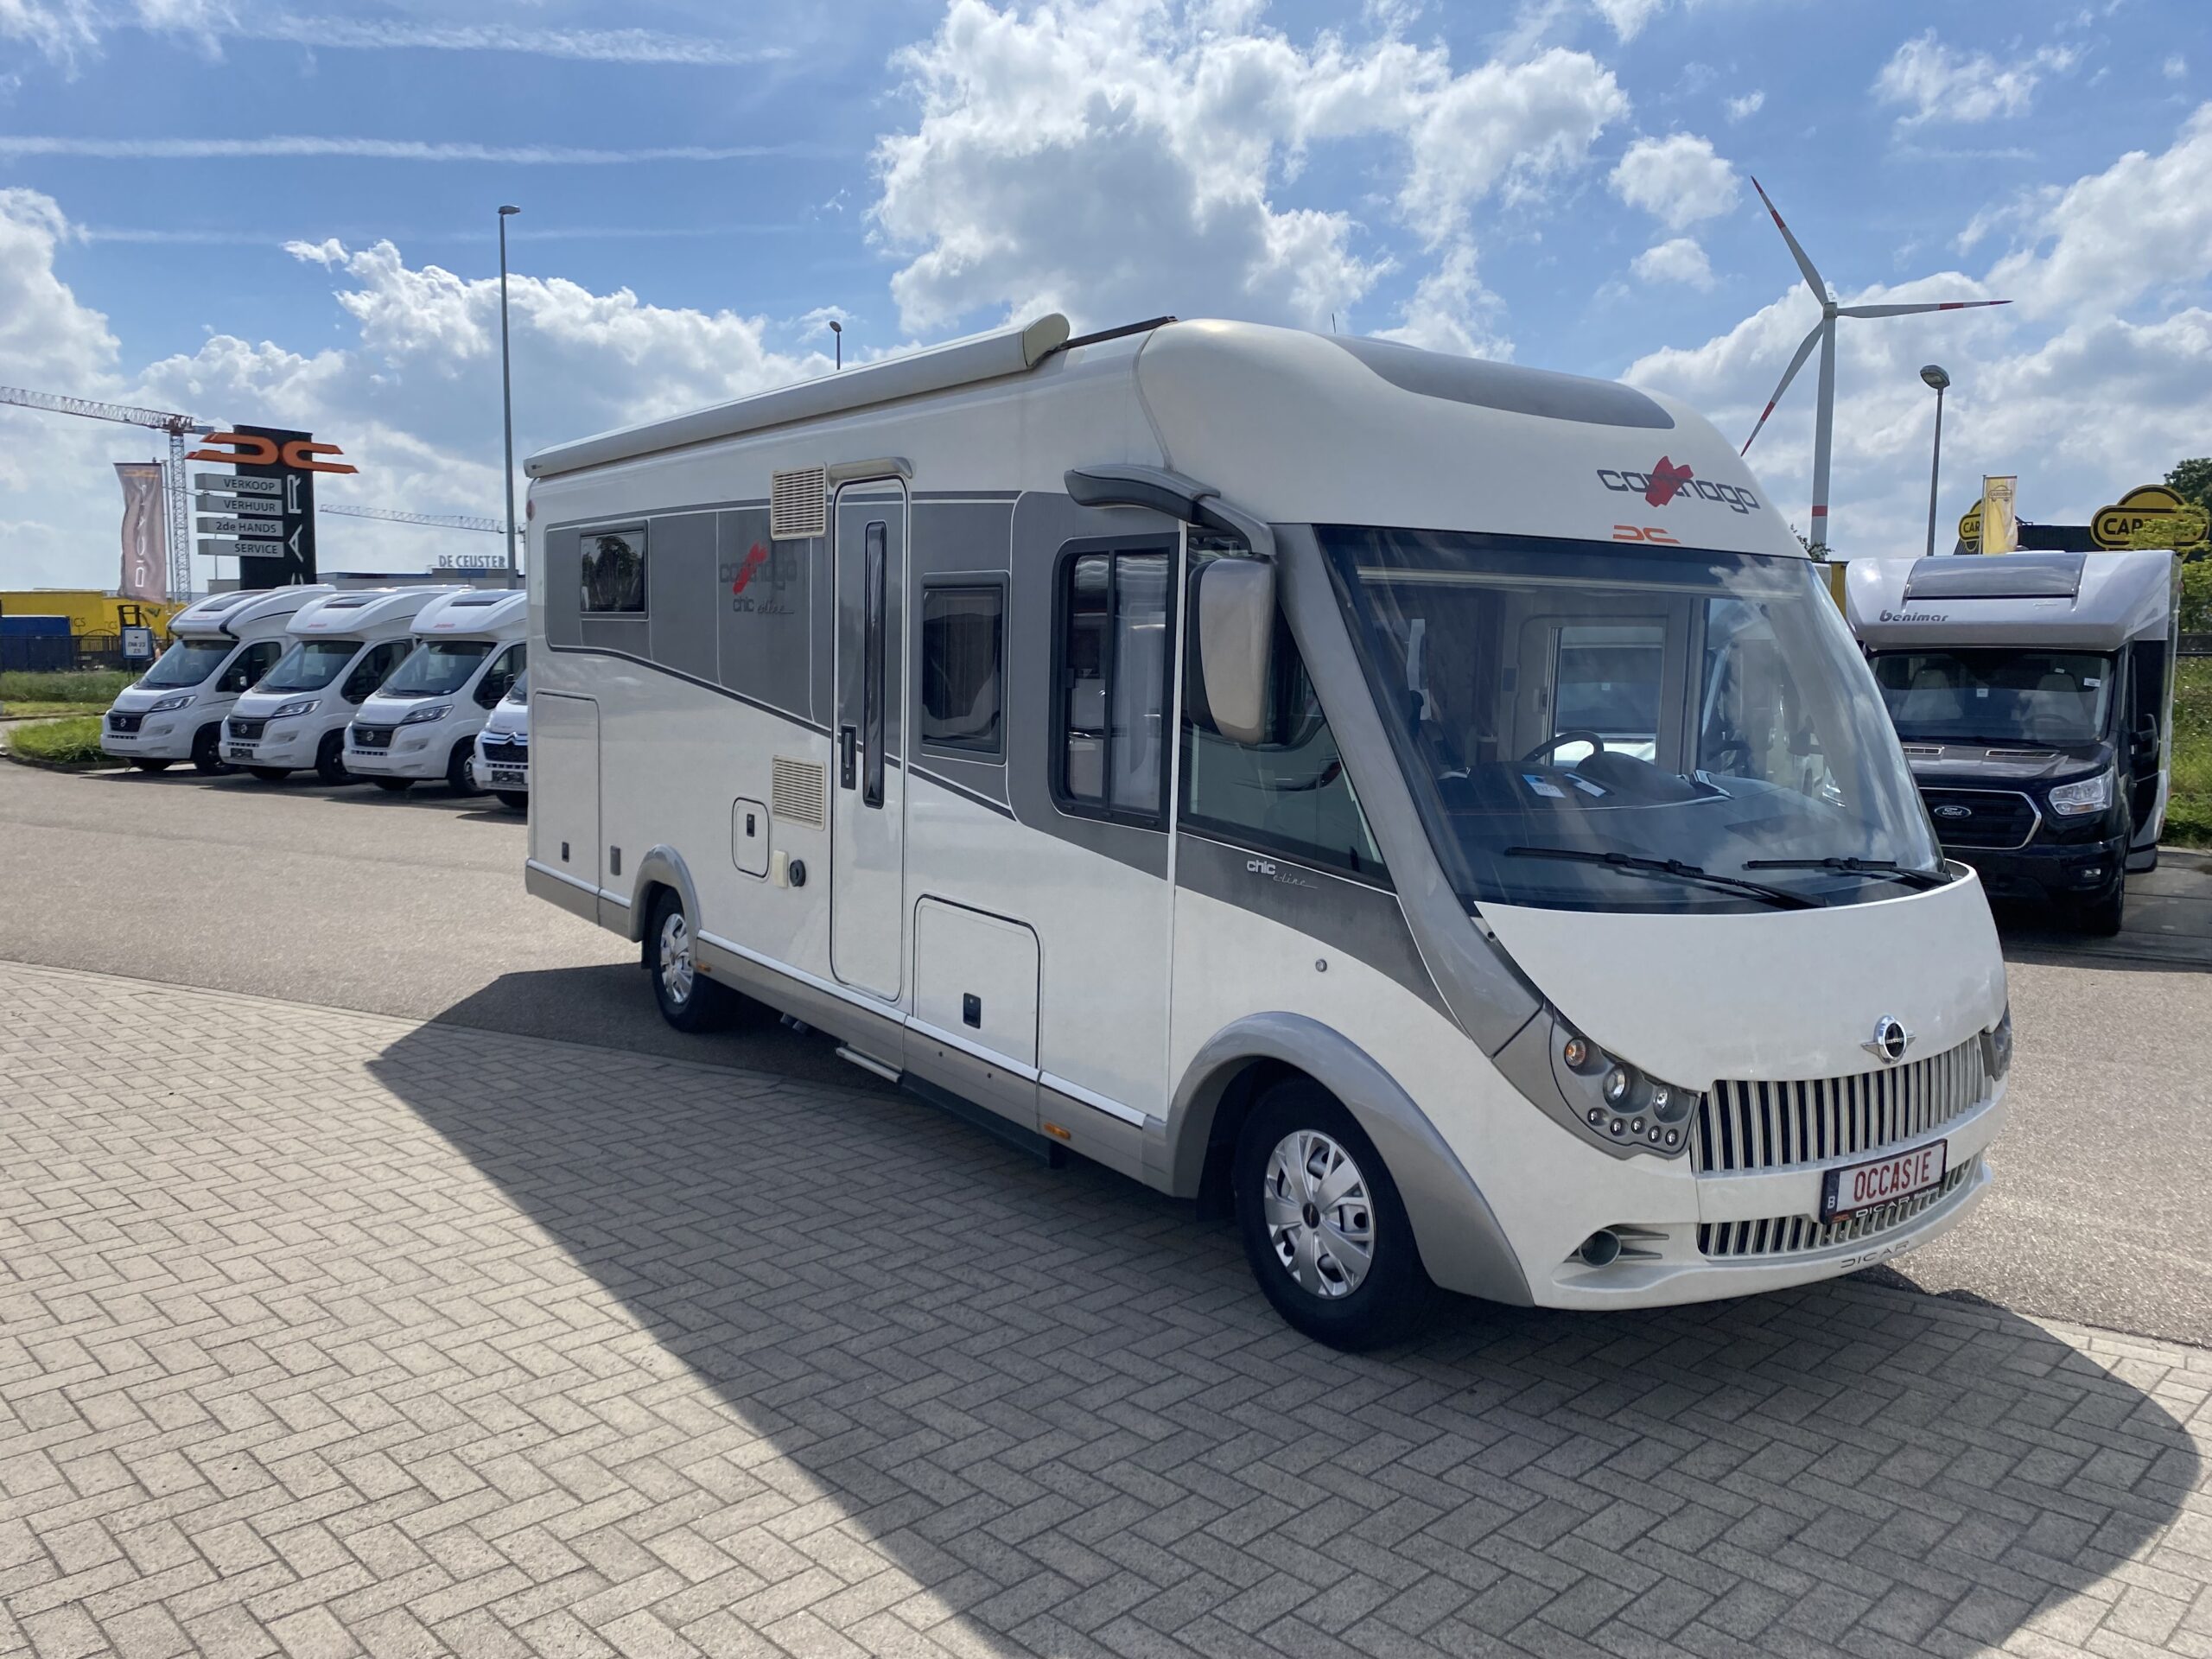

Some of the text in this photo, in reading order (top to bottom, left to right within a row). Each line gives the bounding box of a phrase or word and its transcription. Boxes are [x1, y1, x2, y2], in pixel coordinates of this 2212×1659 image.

[223, 478, 276, 492] VERKOOP
[1597, 469, 1761, 514] cahago
[223, 499, 276, 512] VERHUUR
[216, 520, 277, 533] 2de HANDS
[234, 543, 278, 555] SERVICE
[438, 555, 506, 569] DE CEUSTER
[733, 596, 754, 613] chic
[1879, 609, 1949, 622] benimar
[1942, 807, 1963, 816] Ford
[1246, 860, 1276, 875] chic
[1853, 1151, 1932, 1202] OCCASIE
[1827, 1195, 1836, 1209] B
[1855, 1196, 1910, 1218] DICAR
[1840, 1240, 1910, 1268] DICAR
